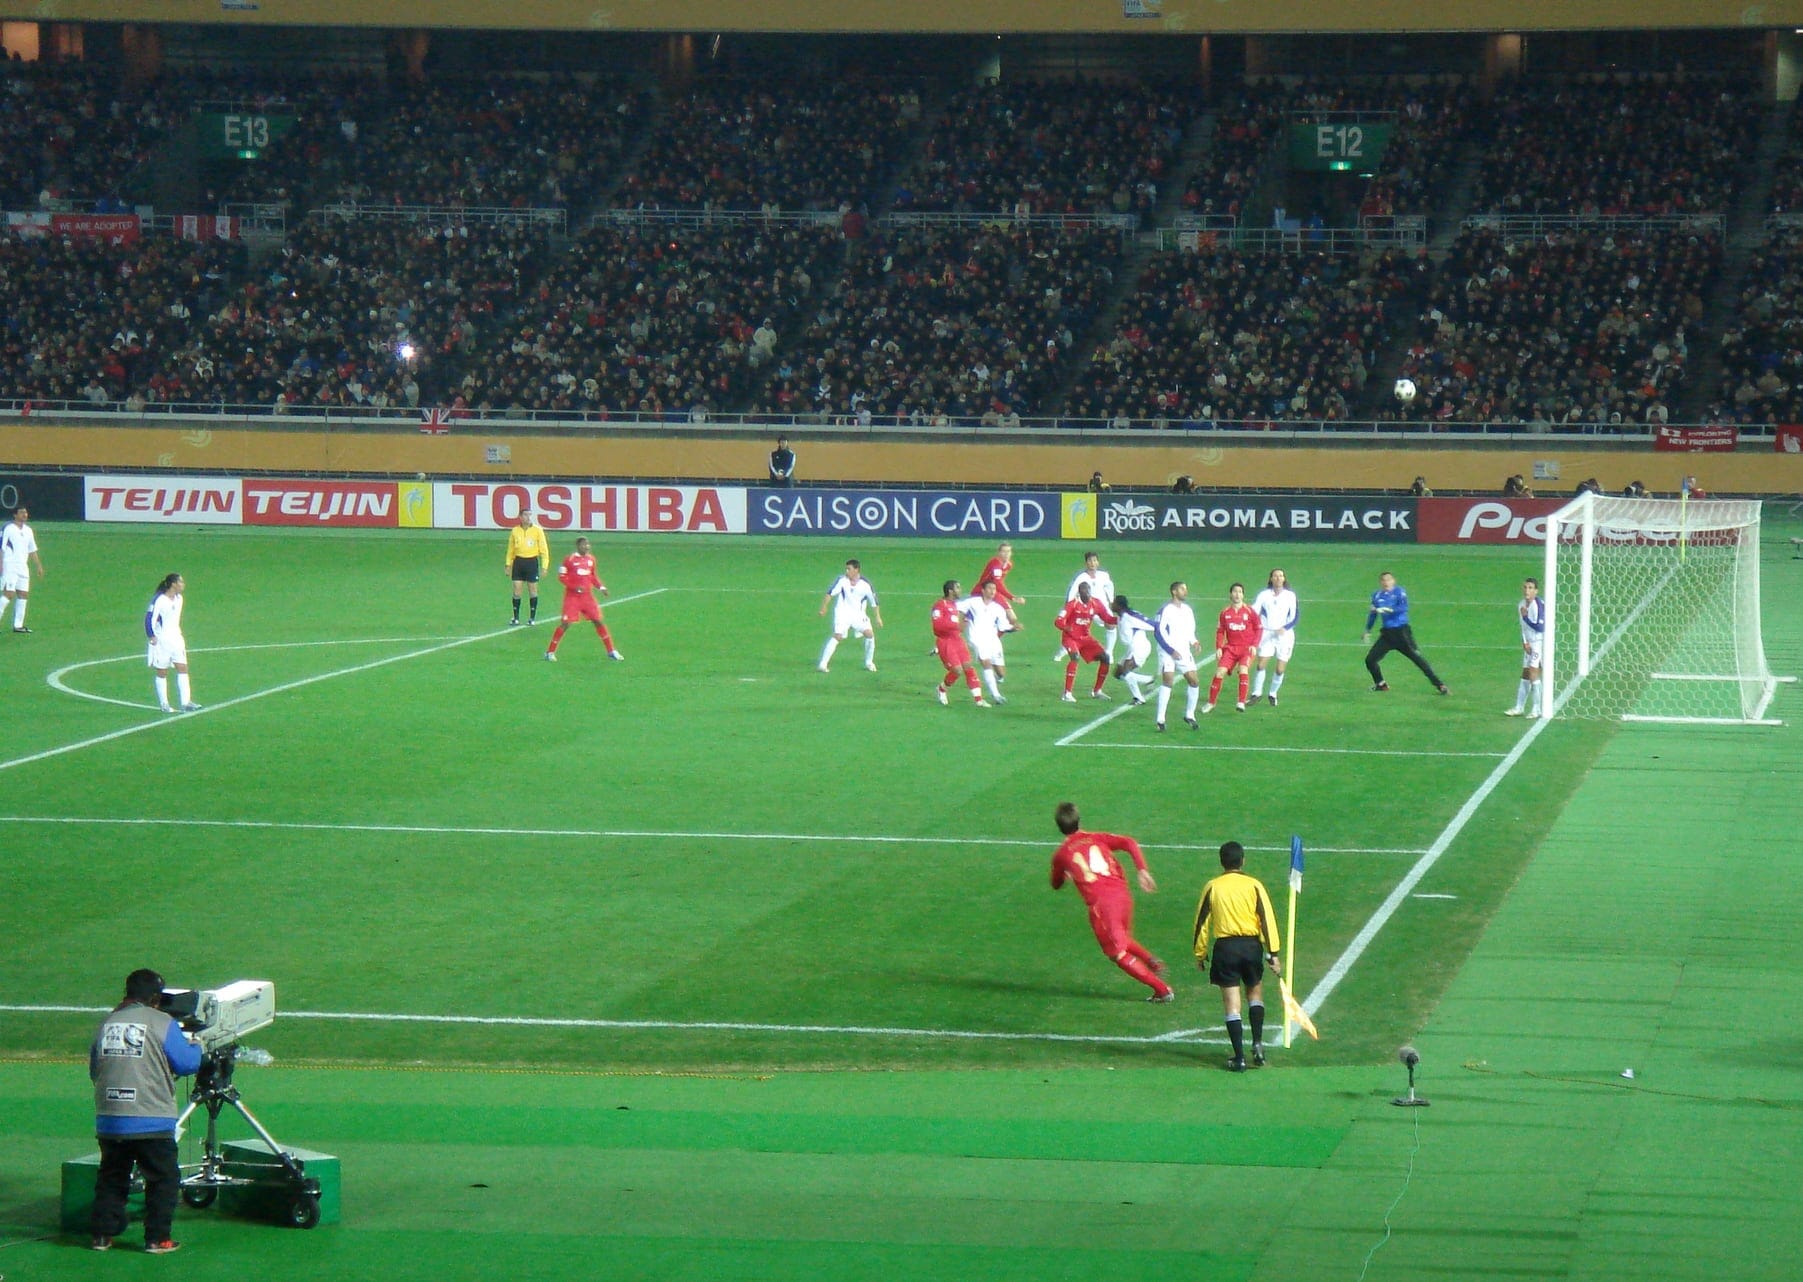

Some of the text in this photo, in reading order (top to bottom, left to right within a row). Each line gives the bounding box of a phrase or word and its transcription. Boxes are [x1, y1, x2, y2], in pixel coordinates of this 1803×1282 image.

[224, 116, 269, 148] E13
[1317, 126, 1363, 157] E12
[60, 222, 71, 231] WE
[75, 222, 89, 231] ARE
[91, 487, 235, 516] TEIJIN
[248, 490, 392, 520] TEIJIN
[451, 484, 728, 531] TOSHIBA
[763, 495, 1045, 533] SAISON CARD
[1102, 509, 1155, 534] Roots
[1162, 508, 1411, 530] AROMA BLACK
[1072, 844, 1111, 883] 14
